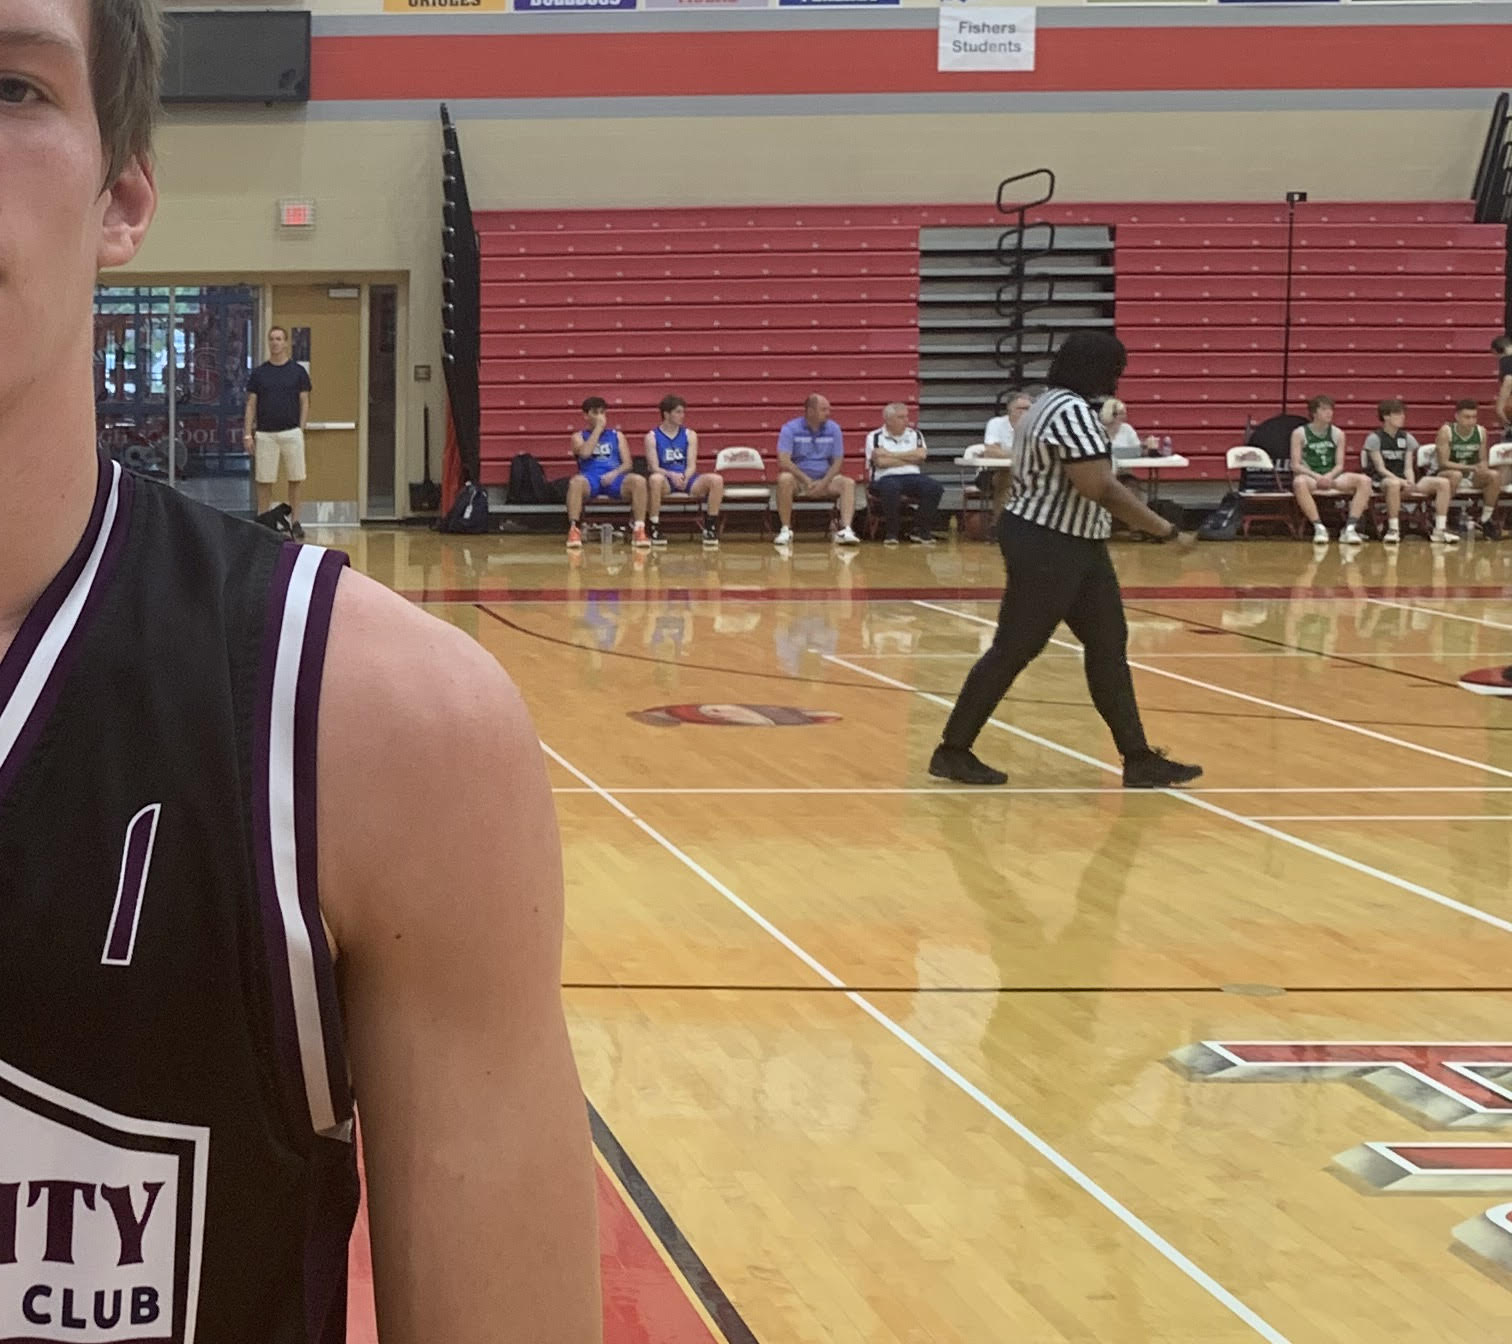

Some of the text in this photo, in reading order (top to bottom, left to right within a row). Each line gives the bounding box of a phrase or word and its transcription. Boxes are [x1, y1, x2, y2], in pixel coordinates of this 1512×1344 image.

[958, 21, 1016, 34] Fishers
[952, 39, 1022, 53] Students
[101, 803, 161, 965] 1
[21, 1283, 161, 1328] CLUB
